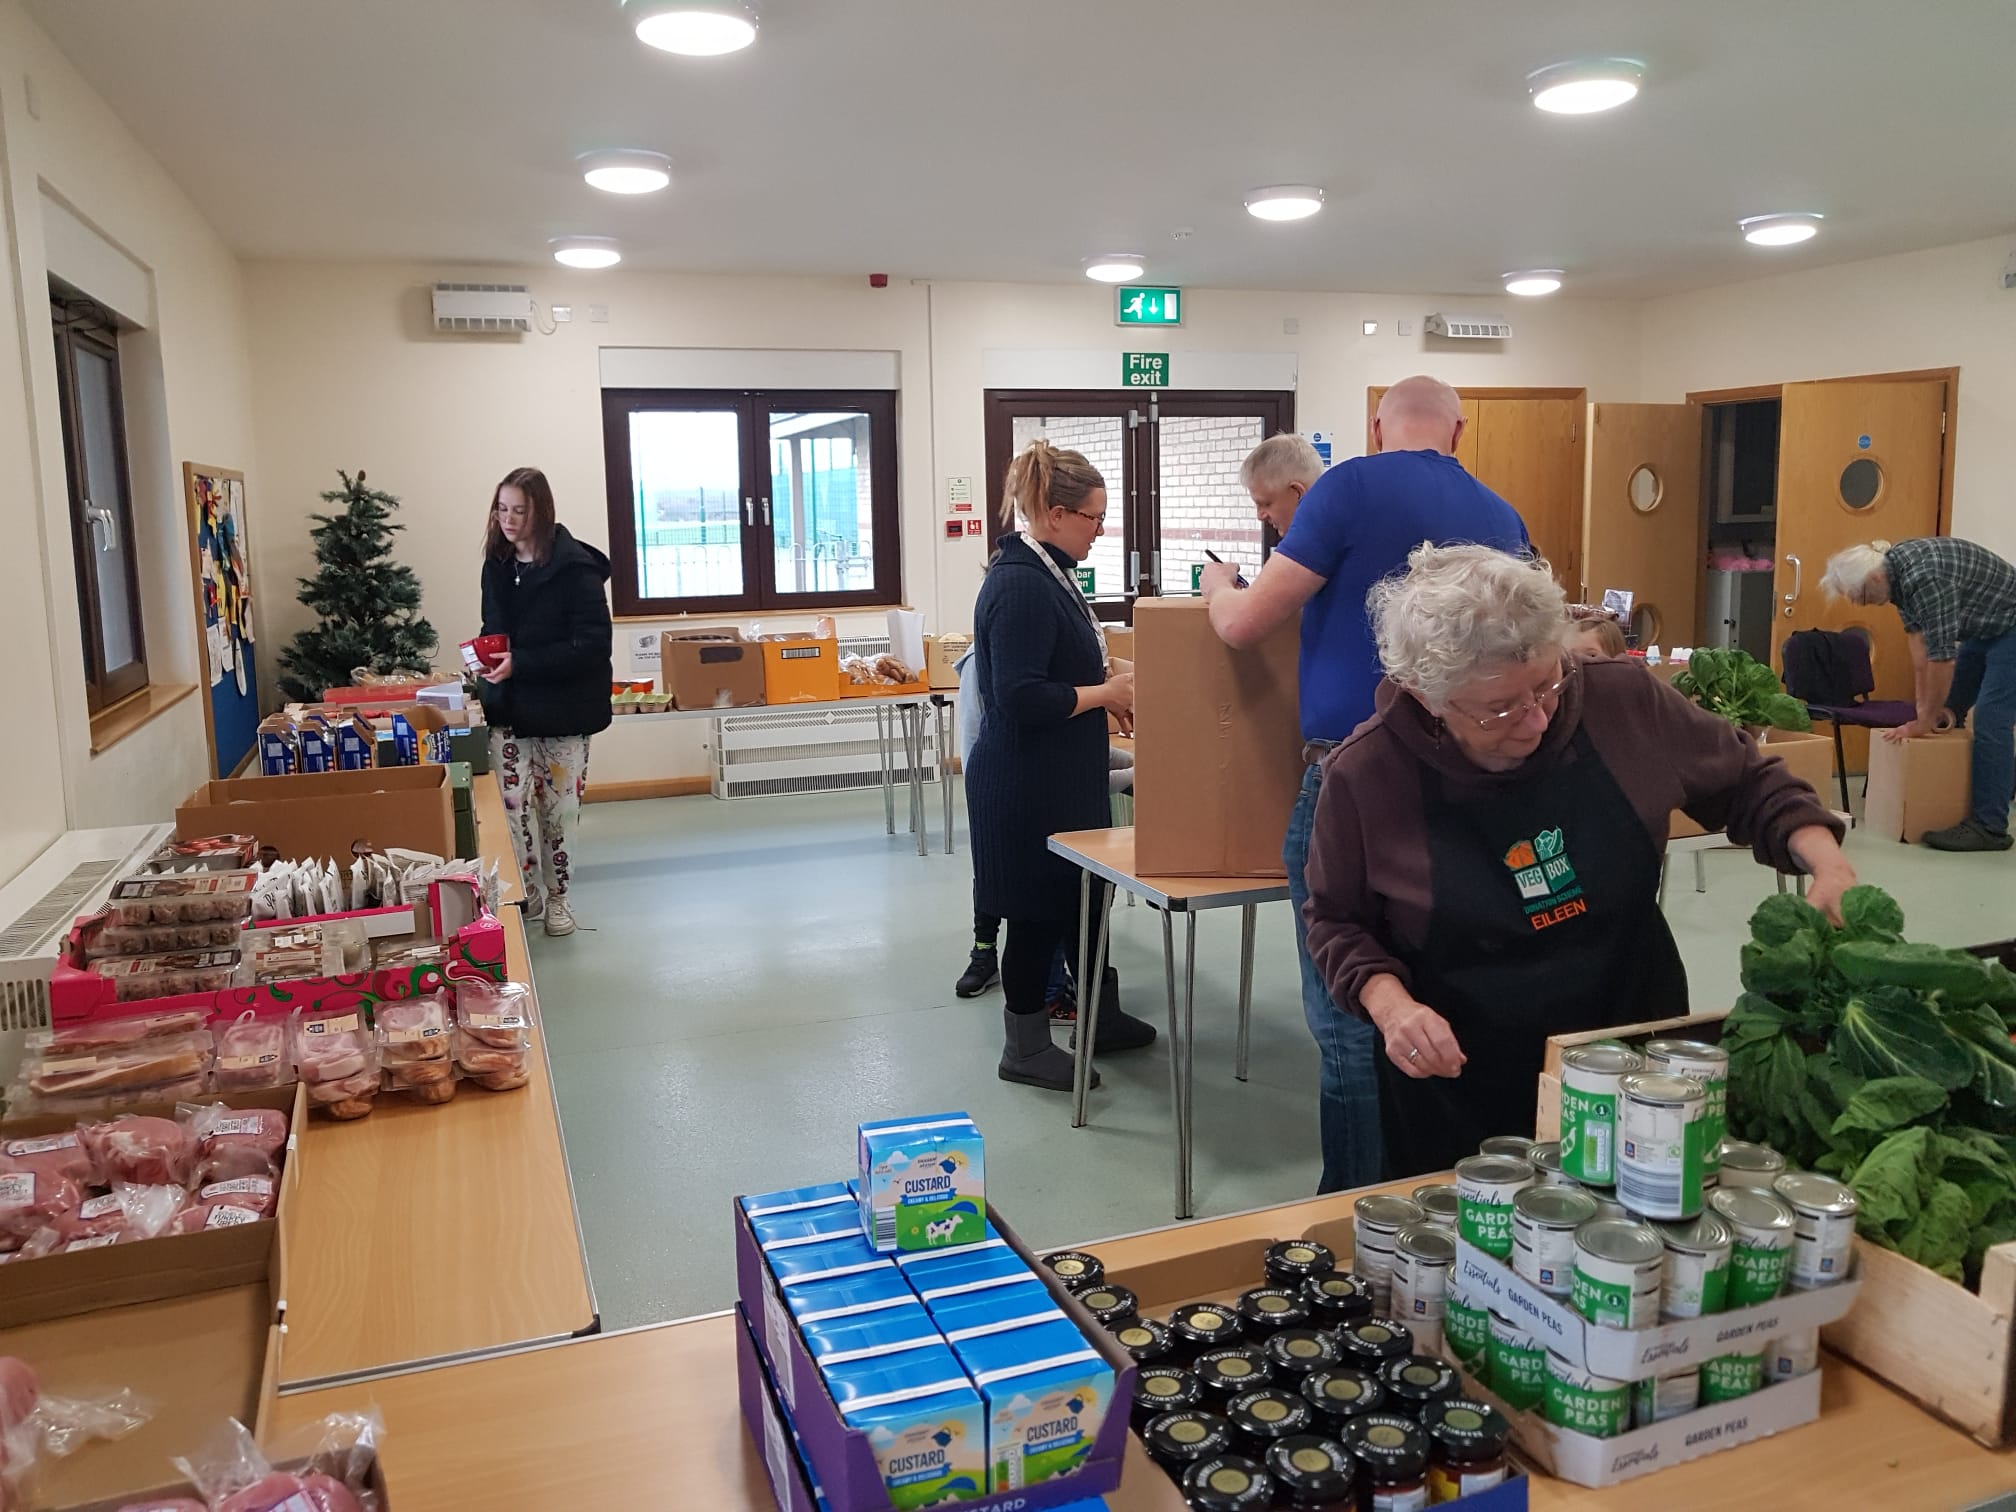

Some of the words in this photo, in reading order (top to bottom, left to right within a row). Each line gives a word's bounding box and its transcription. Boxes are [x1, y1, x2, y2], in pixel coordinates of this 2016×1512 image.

[1129, 354, 1163, 369] Fire
[1130, 370, 1162, 385] exit
[1518, 870, 1543, 888] VEG
[1546, 858, 1570, 880] BOX
[1531, 898, 1587, 930] EILEEN
[904, 1175, 951, 1194] CUSTARD
[1463, 1260, 1501, 1296] Essentials
[1508, 1288, 1540, 1318] GARDEN
[1541, 1312, 1563, 1336] PEAS
[1451, 1322, 1486, 1344] PEAS
[1716, 1326, 1752, 1343] GARDEN
[1755, 1317, 1779, 1333] PEAS
[1553, 1387, 1621, 1412] GARDEN
[1027, 1416, 1078, 1442] CUSTARD
[1565, 1407, 1608, 1426] PEAS
[1685, 1428, 1722, 1447] GARDEN
[1724, 1416, 1749, 1434] PEAS
[889, 1450, 945, 1474] CUSTARD
